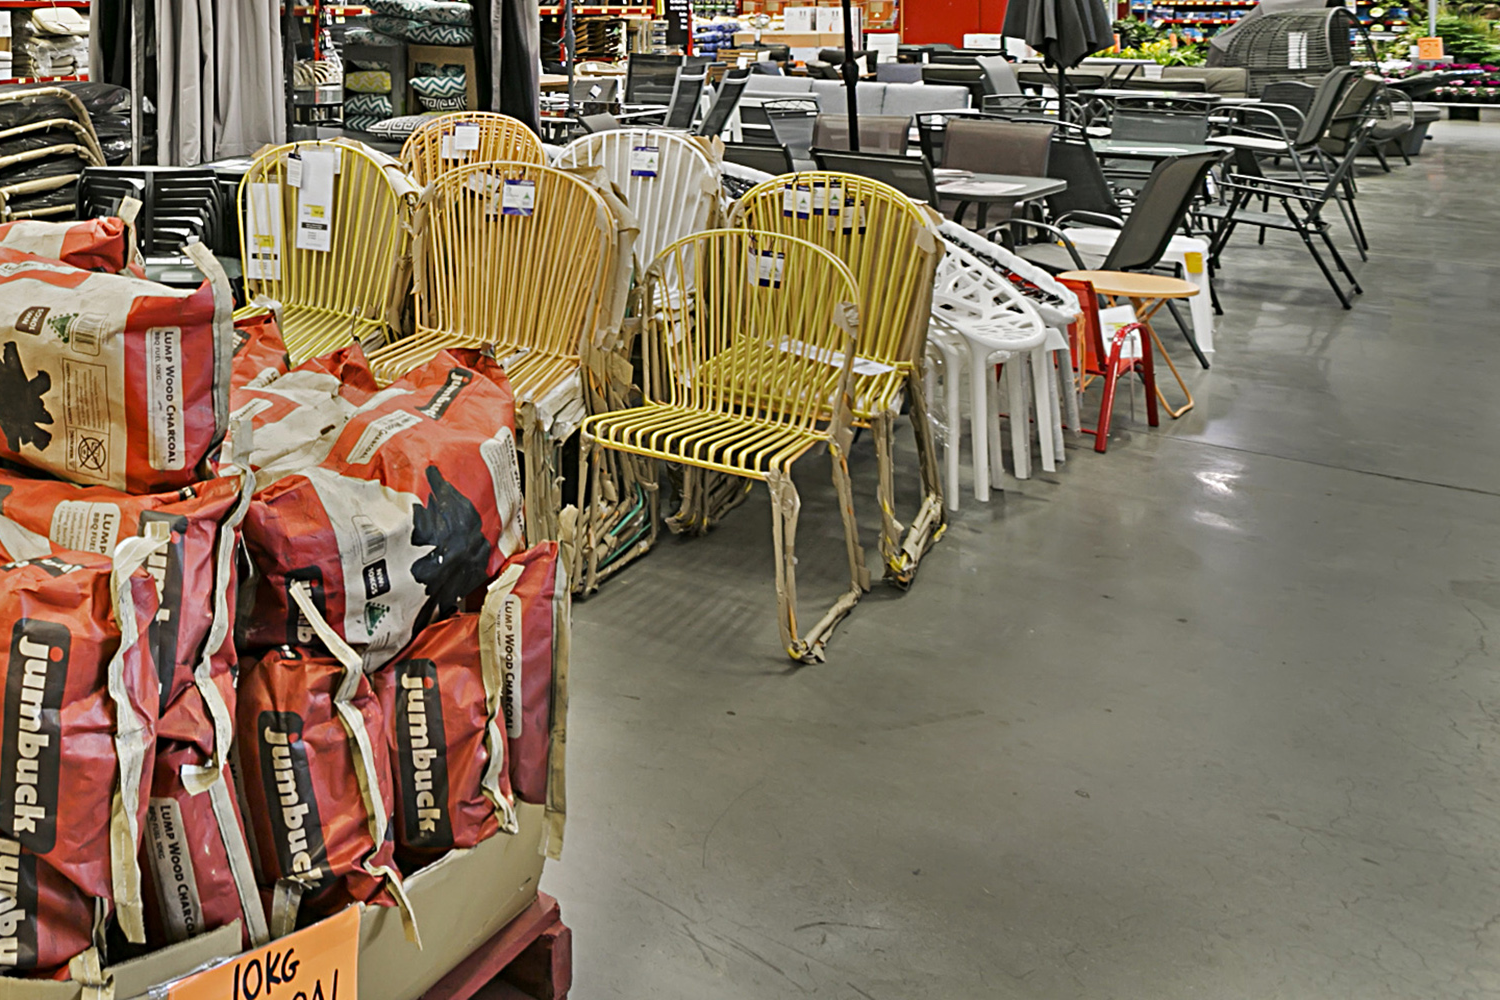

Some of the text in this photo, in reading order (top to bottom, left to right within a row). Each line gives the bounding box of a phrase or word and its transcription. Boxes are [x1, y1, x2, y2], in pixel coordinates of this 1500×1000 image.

[164, 331, 176, 464] LUMP WOOD CHARCOAL
[91, 512, 100, 532] BBQ
[100, 513, 115, 555] LUMP
[504, 600, 516, 731] LUMP WOOD CHARCOAL
[12, 635, 63, 834] jumbuck
[401, 672, 440, 834] jumbuck
[160, 804, 196, 935] LUMP WOOD CHARCO
